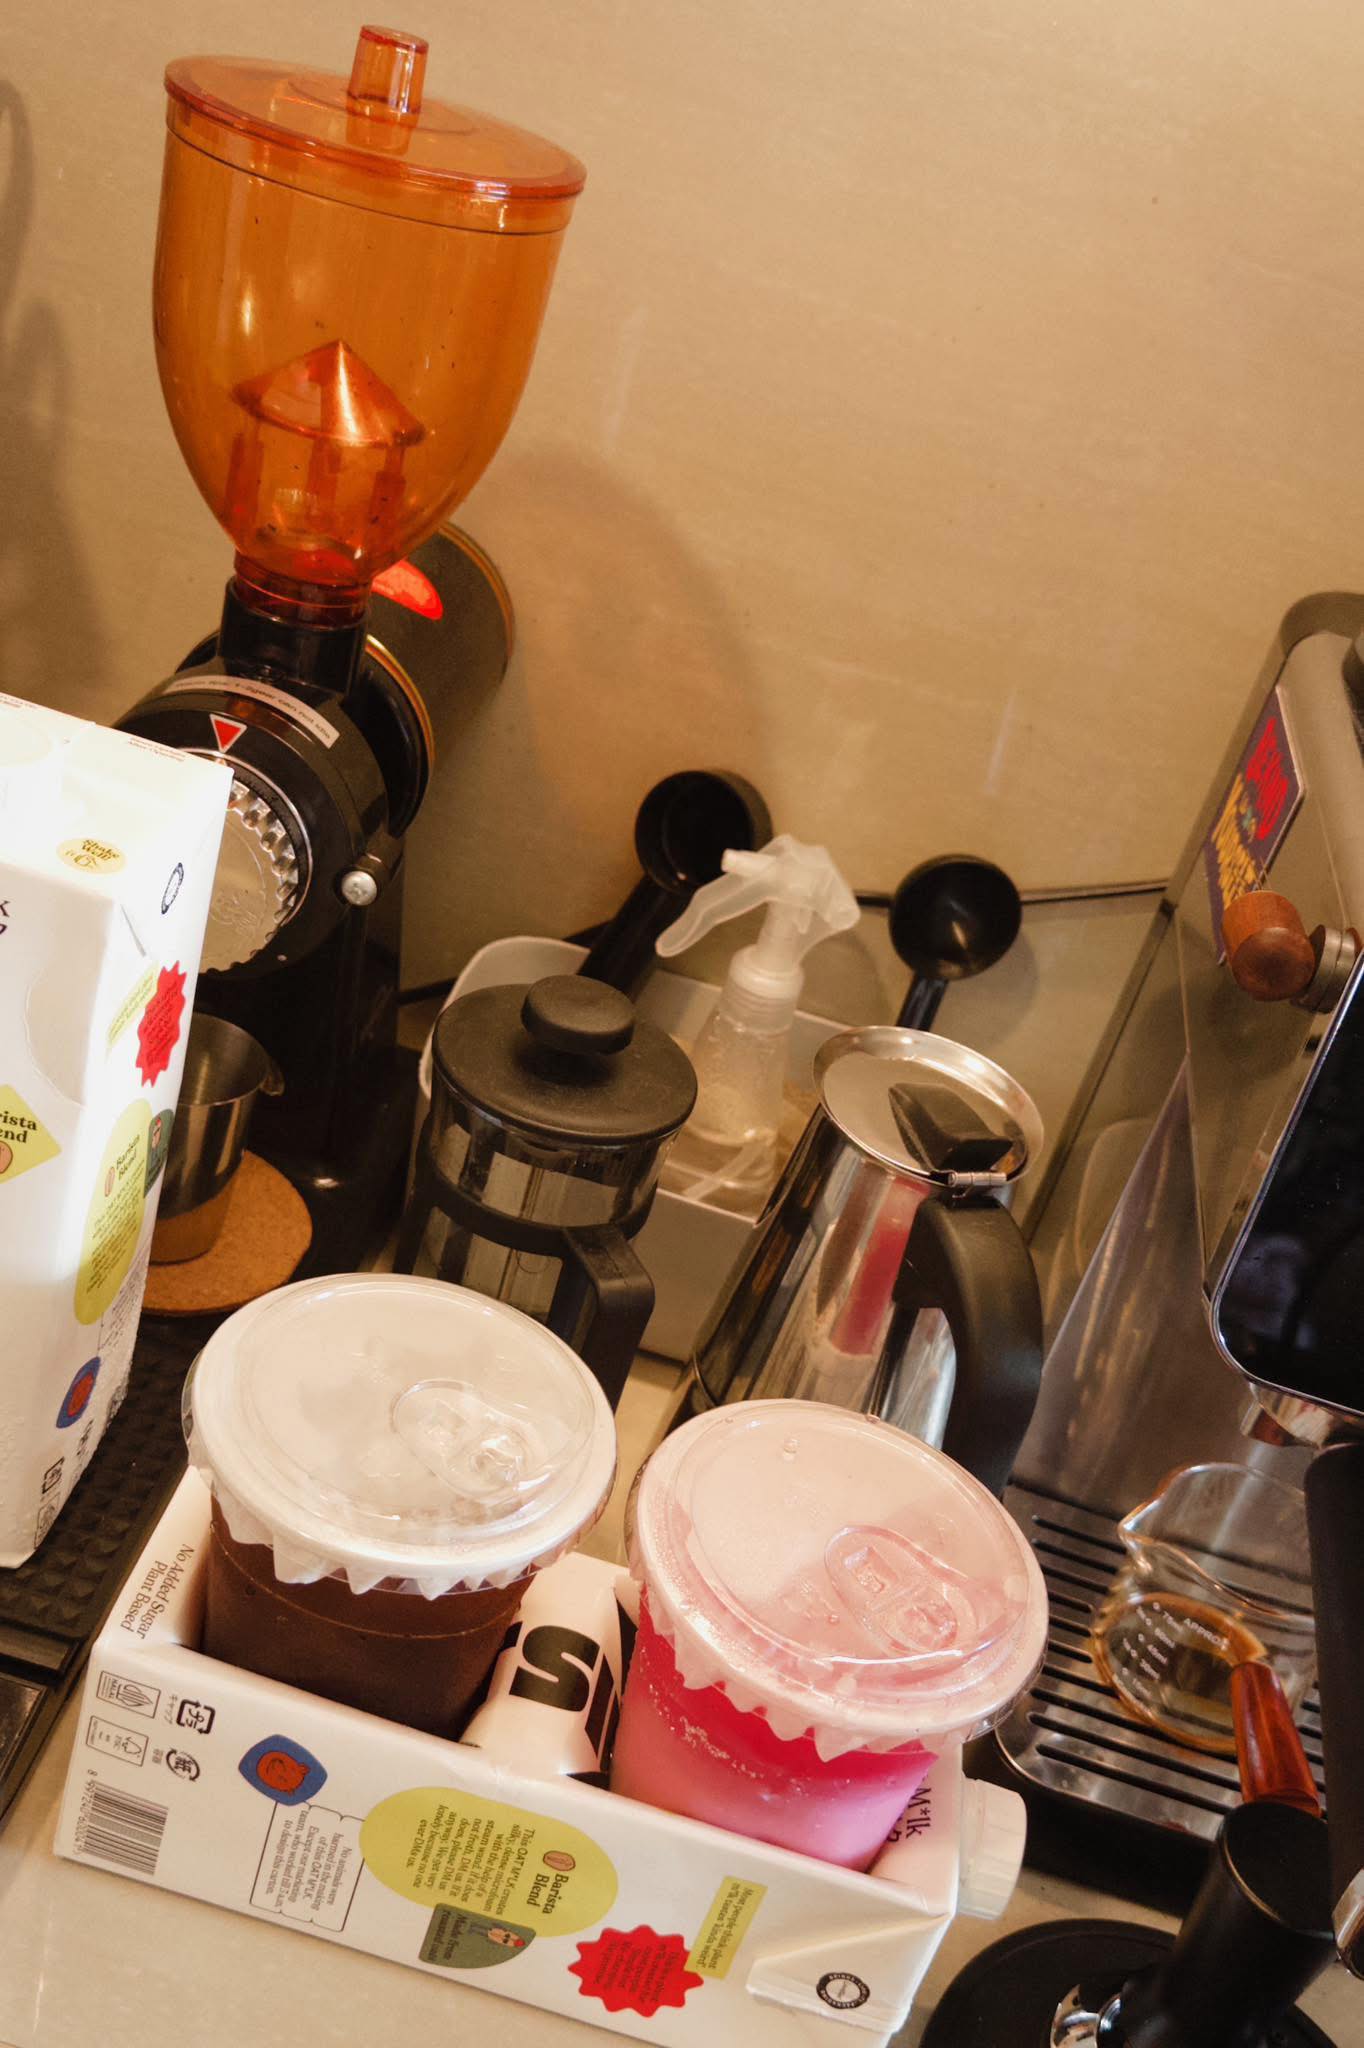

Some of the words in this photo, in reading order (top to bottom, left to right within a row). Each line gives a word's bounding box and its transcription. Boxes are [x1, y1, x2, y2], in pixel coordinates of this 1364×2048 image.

[0, 1110, 37, 1131] ista
[175, 1543, 195, 1564] No
[141, 1560, 168, 1594] Plant
[155, 1561, 186, 1602] Added
[120, 1591, 151, 1632] Based
[133, 1598, 166, 1640] Sugar
[172, 1755, 193, 1773] 紙
[416, 1818, 428, 1836] ever
[429, 1804, 448, 1830] lonely
[471, 1818, 482, 1832] not
[275, 1828, 290, 1855] design
[291, 1833, 303, 1850] who
[480, 1819, 495, 1845] steam
[492, 1833, 506, 1851] with
[520, 1827, 535, 1847] This
[314, 1846, 326, 1861] this
[326, 1832, 344, 1863] harmed
[410, 1837, 424, 1857] DMs
[421, 1830, 440, 1863] because
[445, 1839, 463, 1866] please
[514, 1847, 528, 1866] OAT
[272, 1854, 285, 1869] this
[284, 1850, 297, 1877] worked
[430, 1858, 441, 1871] get
[487, 1851, 499, 1865] the
[499, 1846, 515, 1871] dense
[308, 1860, 322, 1879] OAT
[320, 1870, 332, 1884] the
[331, 1858, 349, 1888] animals
[413, 1873, 423, 1887] one
[424, 1871, 436, 1888] very
[479, 1865, 495, 1883] help
[287, 1866, 308, 1903] marketing
[461, 1884, 475, 1902] does
[483, 1870, 505, 1912] microfoam
[527, 1873, 550, 1907] Blend
[542, 1872, 569, 1916] Barista
[310, 1883, 328, 1911] making
[326, 1887, 337, 1904] were
[496, 1888, 510, 1915] creates
[736, 1887, 755, 1905] Most
[726, 1903, 743, 1930] people
[716, 1929, 734, 1949] think
[707, 1948, 723, 1970] plant
